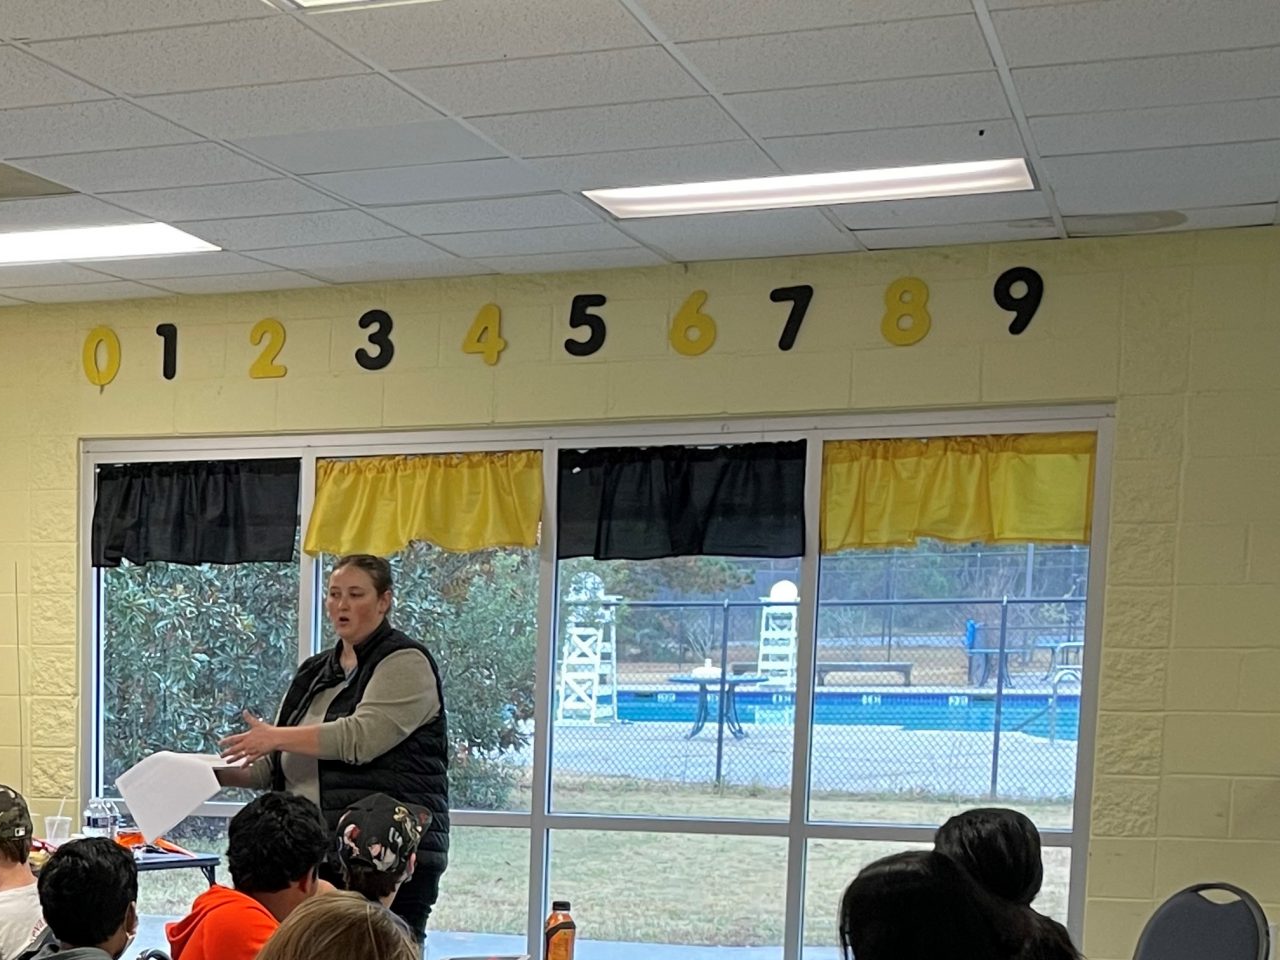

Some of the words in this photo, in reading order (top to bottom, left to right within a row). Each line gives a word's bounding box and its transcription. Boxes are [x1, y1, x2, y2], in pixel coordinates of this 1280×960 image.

[83, 325, 121, 387] 0
[156, 323, 178, 380] 1
[250, 318, 287, 379] 2
[355, 309, 394, 370] 3
[462, 303, 507, 366] 4
[564, 294, 607, 356] 5
[670, 290, 716, 356] 6
[769, 285, 814, 351] 7
[881, 276, 932, 346] 8
[993, 266, 1044, 335] 9
